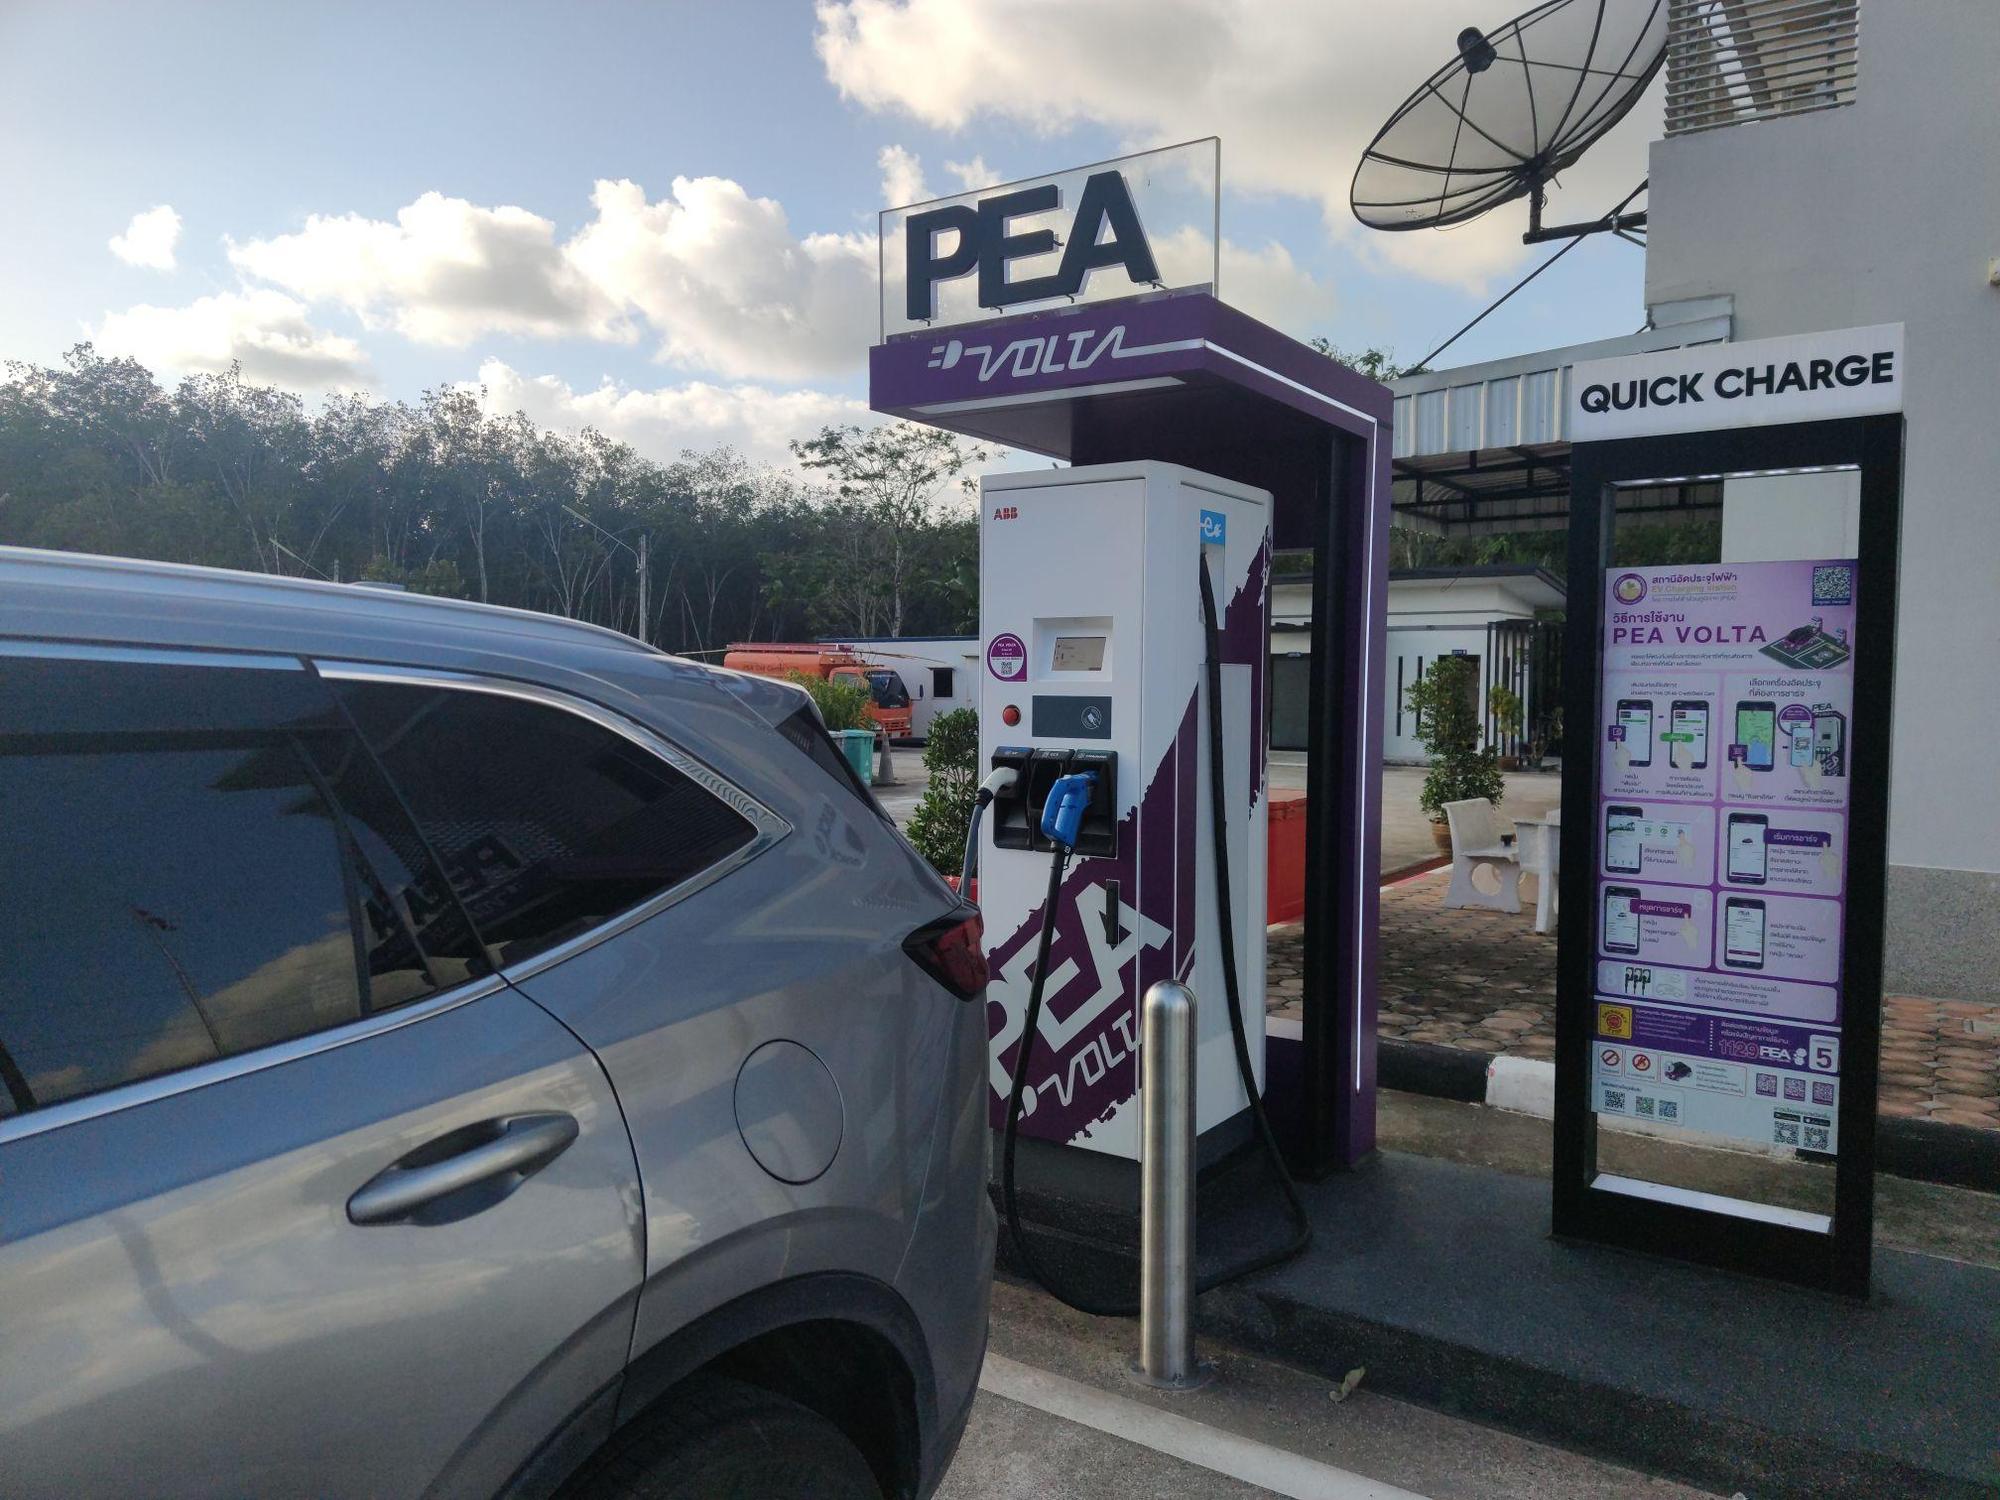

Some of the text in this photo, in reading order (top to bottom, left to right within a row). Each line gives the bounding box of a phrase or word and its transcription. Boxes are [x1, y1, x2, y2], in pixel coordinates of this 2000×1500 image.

[906, 170, 1160, 321] PEA
[964, 325, 1128, 382] VOLTA
[1580, 351, 1894, 413] QUICK CHARGE
[993, 506, 1018, 522] ABB
[1613, 611, 1685, 624] วิธีการใช้งาน
[1613, 625, 1767, 644] PEA VOLTA
[986, 882, 1172, 1100] PEA
[1037, 1009, 1143, 1107] VOLT
[1719, 1039, 1791, 1061] 1129 PEA
